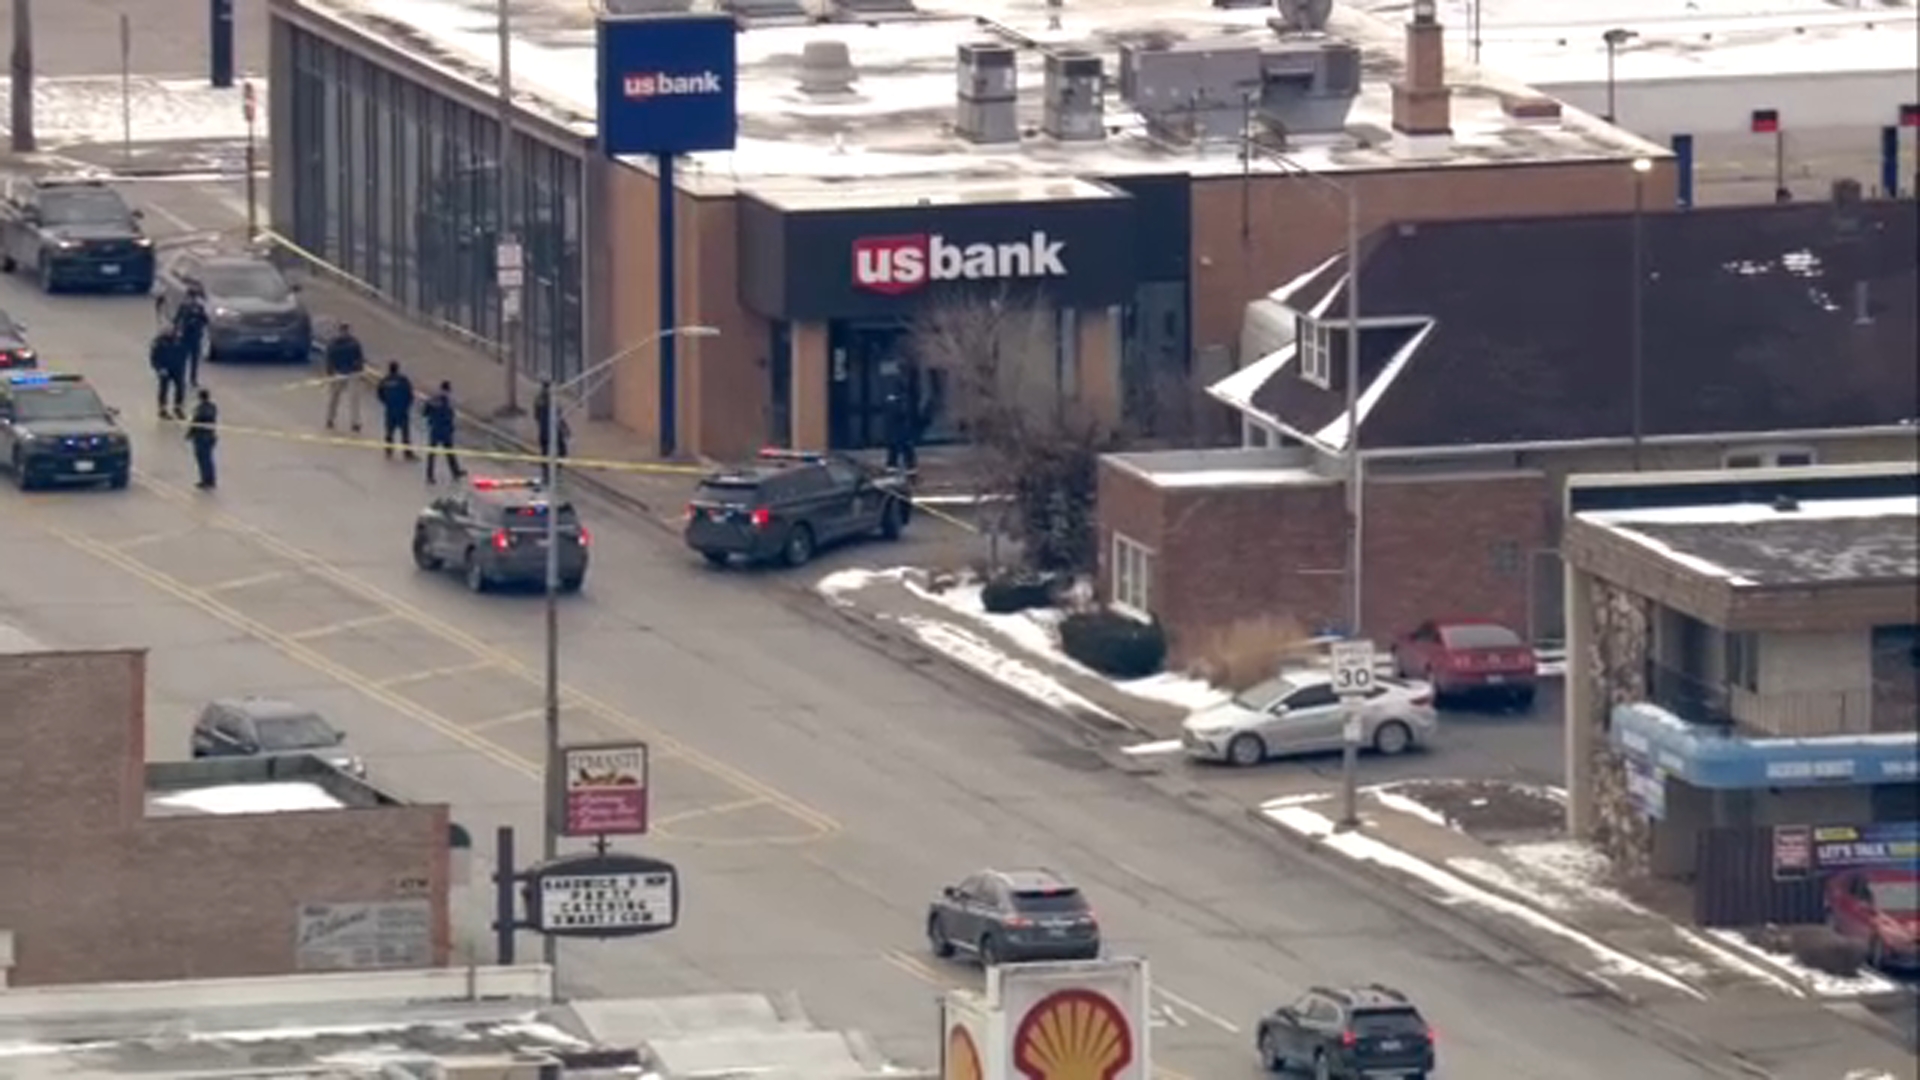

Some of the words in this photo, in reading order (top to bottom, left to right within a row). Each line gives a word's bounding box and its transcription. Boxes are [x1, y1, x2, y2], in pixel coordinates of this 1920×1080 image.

[1338, 668, 1369, 687] 30
[572, 889, 630, 900] PARTY
[561, 900, 646, 912] CATERING
